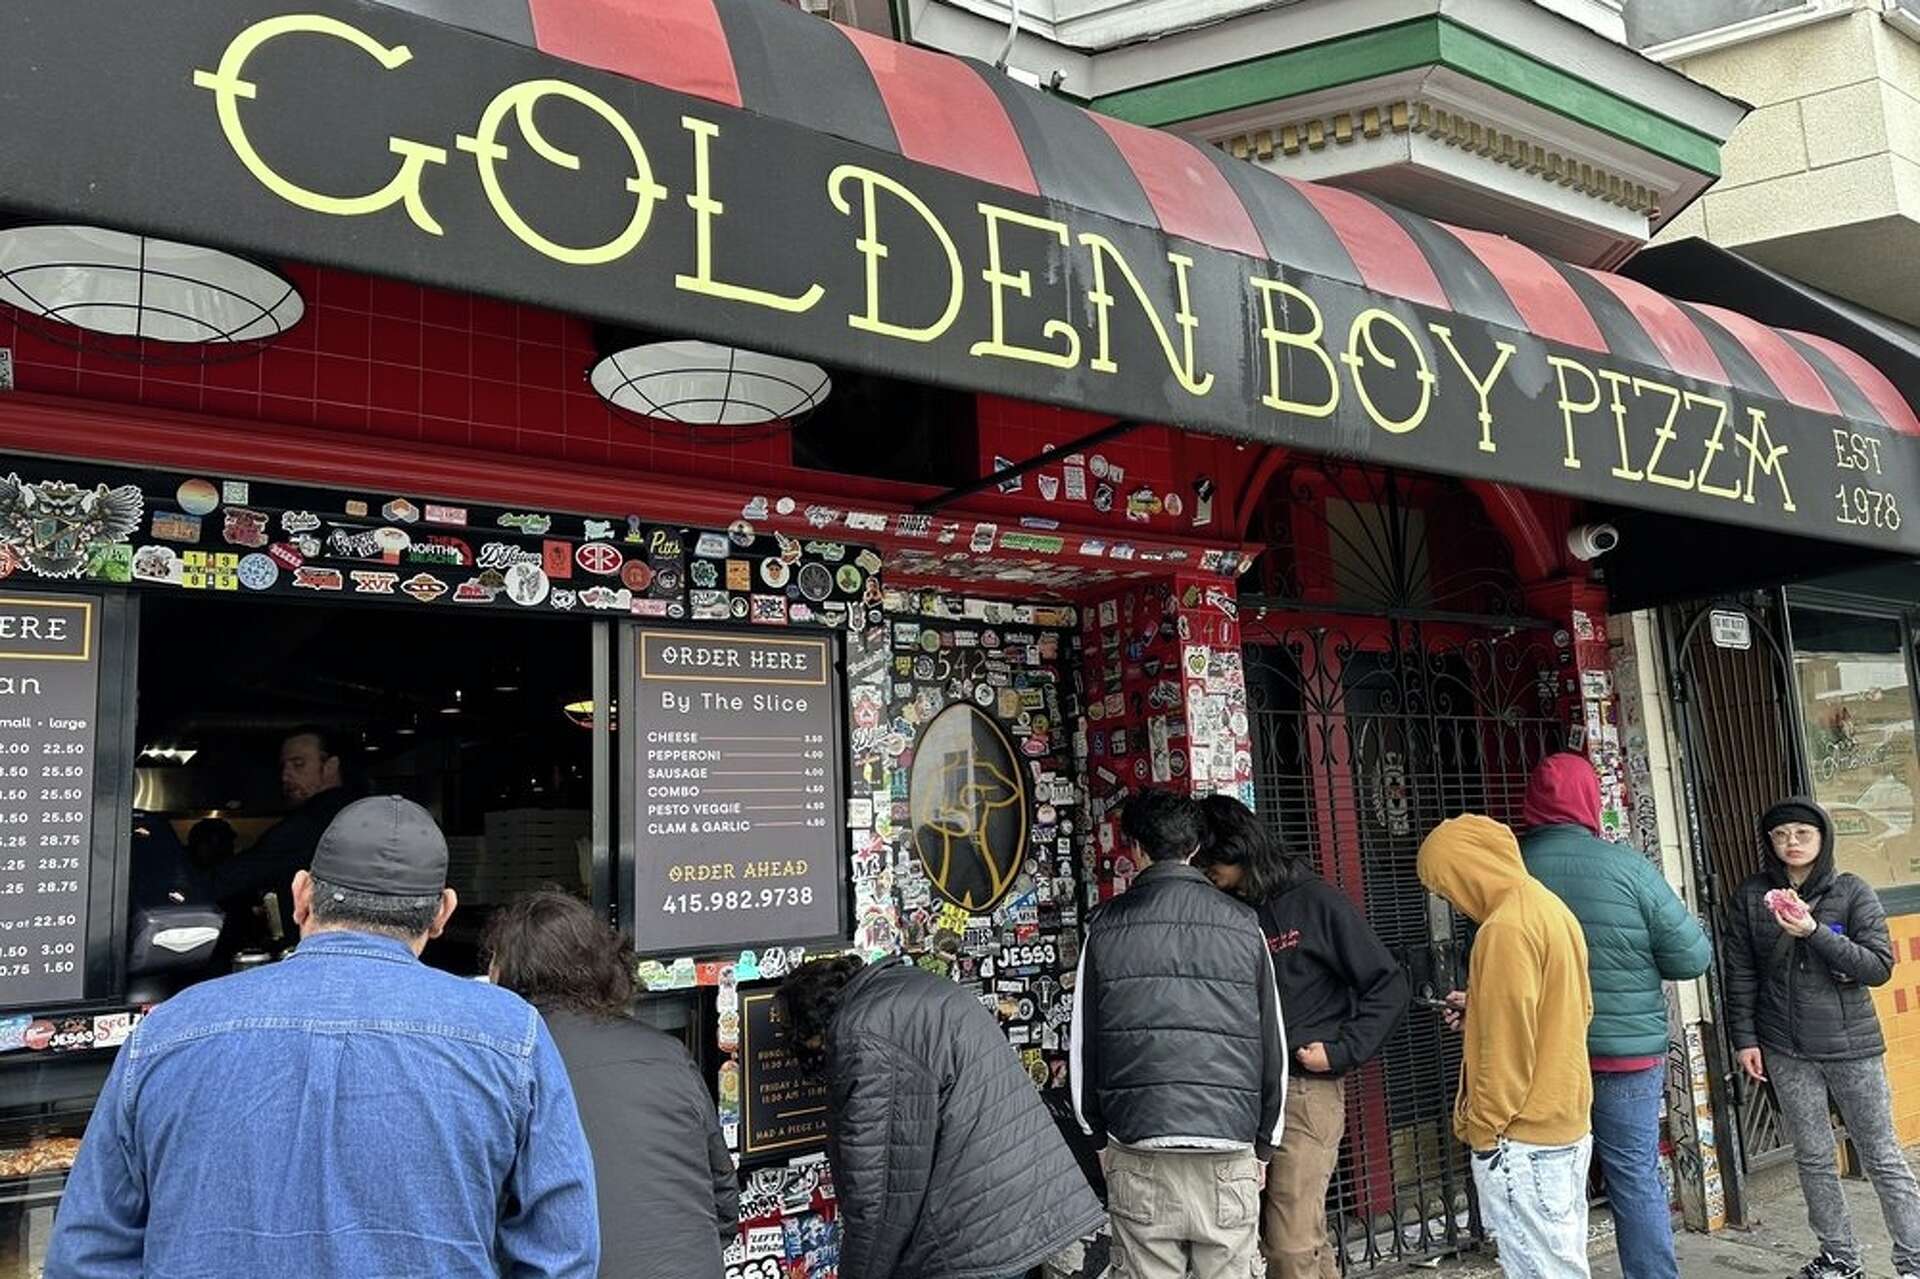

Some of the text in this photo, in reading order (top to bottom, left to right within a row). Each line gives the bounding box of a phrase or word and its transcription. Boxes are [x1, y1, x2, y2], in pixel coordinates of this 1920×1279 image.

[193, 13, 1796, 512] GOLDEN BOY PIZZA
[1833, 429, 1882, 475] EST
[1835, 484, 1902, 530] 1978
[408, 543, 454, 554] NORTH
[661, 646, 808, 671] ORDER HERE
[662, 691, 808, 713] By The Slice
[50, 717, 87, 731] large
[647, 731, 698, 744] CHEESE
[43, 743, 84, 755] 22.50
[648, 750, 721, 762] PEPPERONI
[42, 766, 83, 778] 25.50
[648, 768, 708, 780] SAUSAGE
[40, 788, 82, 800] 25.50
[647, 785, 700, 798] COMBO
[648, 804, 690, 816] PESTO
[694, 802, 741, 814] VEGGIE
[41, 811, 83, 823] 25.50
[648, 822, 686, 834] CLAM
[690, 821, 699, 833] &
[702, 818, 751, 832] GARLIC
[40, 835, 80, 846] 28.75
[38, 858, 79, 869] 28.75
[668, 859, 808, 882] ORDER AHEAD
[37, 881, 78, 893] 28.75
[662, 886, 814, 914] 415.982.9738
[33, 914, 76, 927] 22.50
[41, 942, 75, 956] 3.00
[997, 944, 1057, 968] JESS3
[43, 961, 74, 974] 1.50
[50, 1030, 95, 1047] JESS3
[756, 1128, 777, 1140] HAD
